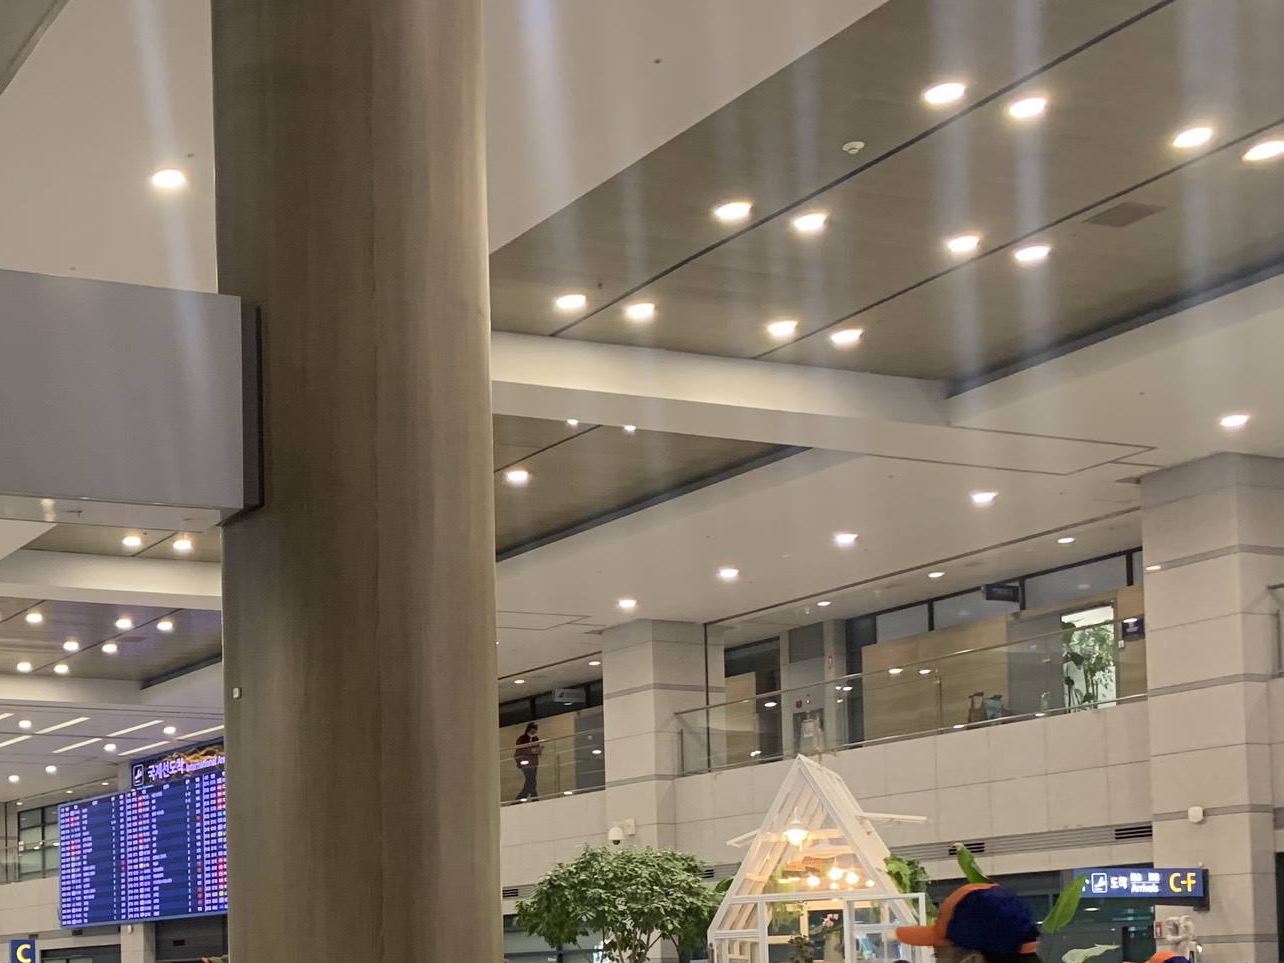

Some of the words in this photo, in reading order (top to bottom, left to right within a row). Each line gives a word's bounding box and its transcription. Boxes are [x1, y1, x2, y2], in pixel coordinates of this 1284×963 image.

[1131, 883, 1159, 893] Arrivals
[1169, 872, 1197, 893] C-F
[16, 943, 31, 963] C
